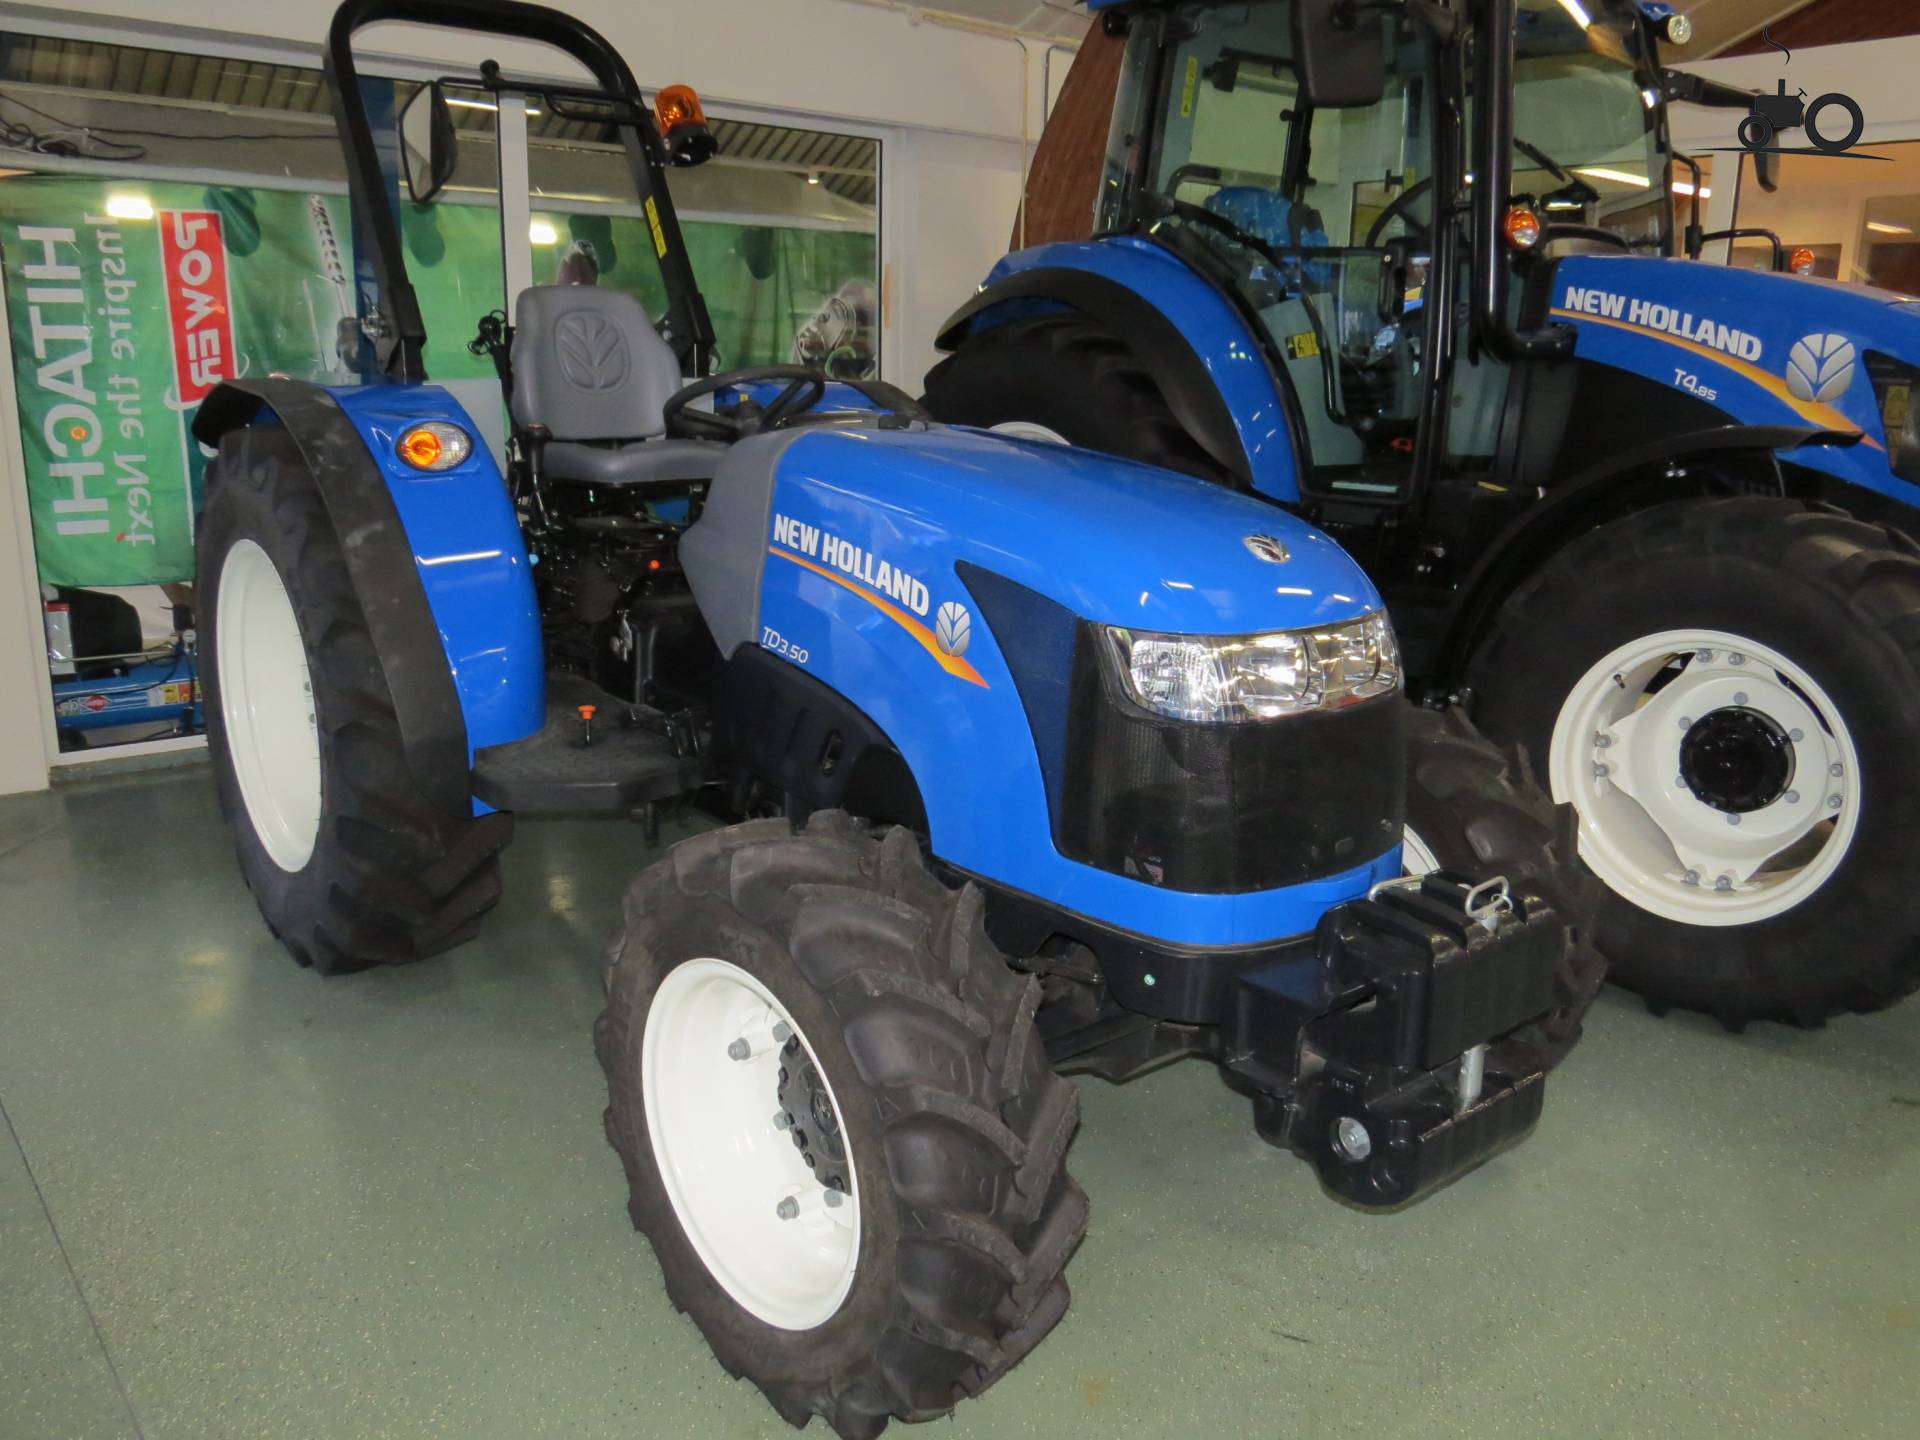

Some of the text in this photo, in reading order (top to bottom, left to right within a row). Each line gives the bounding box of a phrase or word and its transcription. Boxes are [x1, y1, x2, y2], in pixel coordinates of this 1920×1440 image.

[1565, 286, 1762, 362] NEW HOLLAND
[1674, 368, 1717, 401] T4.85
[774, 513, 929, 617] NEW HOLLAND
[761, 626, 809, 664] TD3.50
